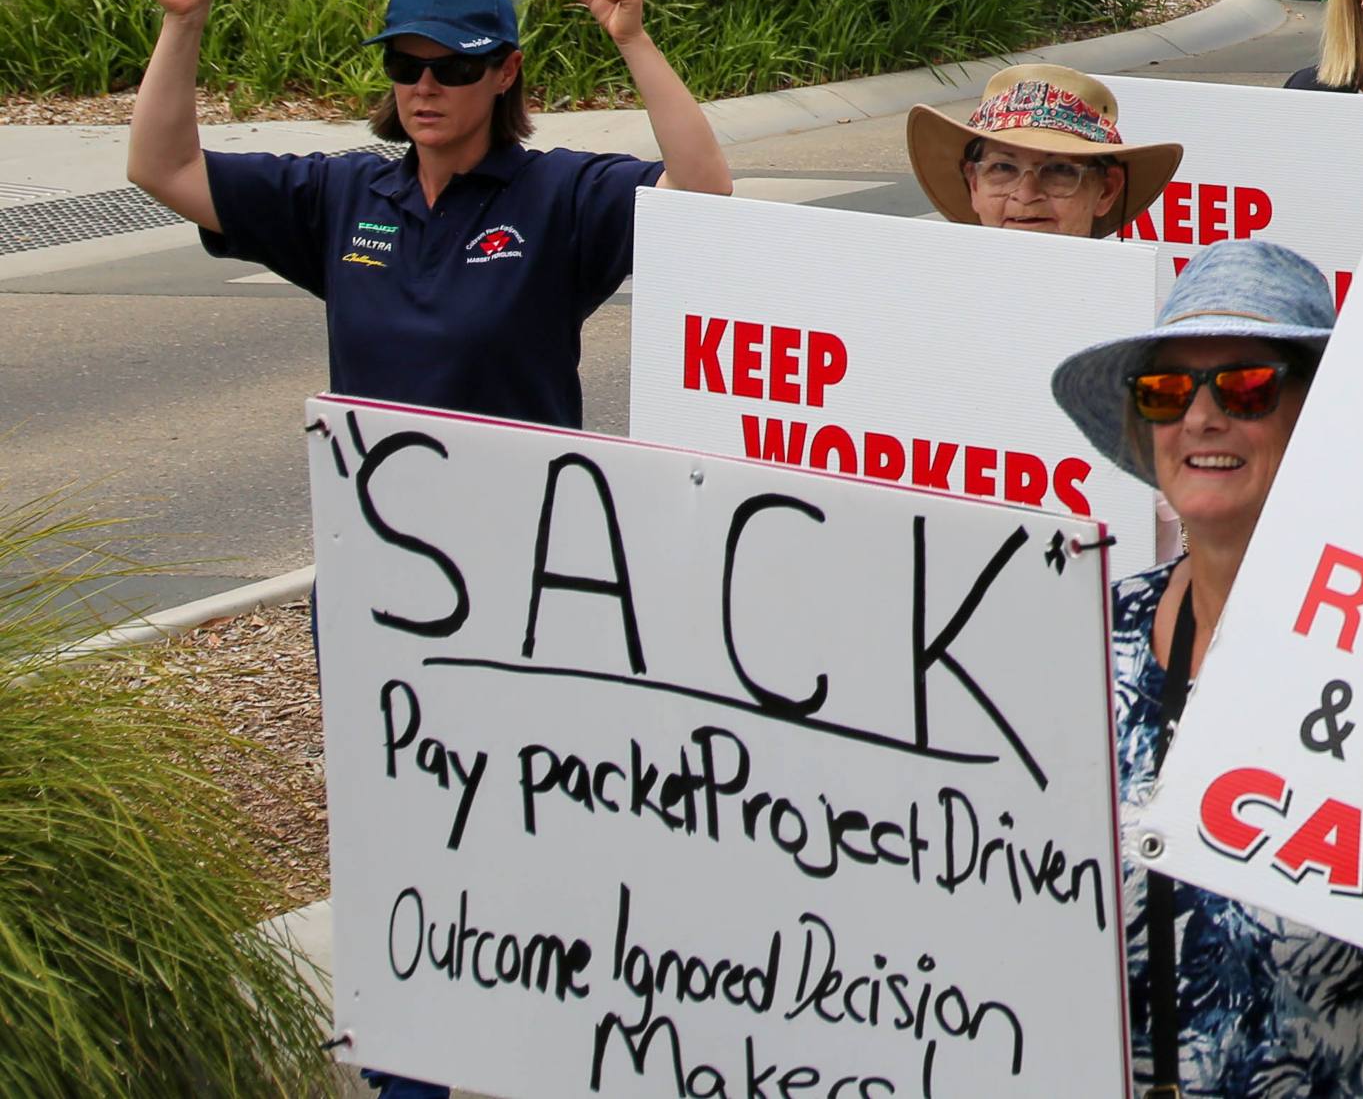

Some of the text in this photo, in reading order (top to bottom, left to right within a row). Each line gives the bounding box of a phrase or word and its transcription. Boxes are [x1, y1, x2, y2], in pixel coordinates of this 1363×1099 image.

[353, 236, 392, 252] VALTRA
[682, 314, 848, 408] KEEP
[741, 413, 1092, 517] WORKERS
[1299, 678, 1357, 761] &
[380, 679, 487, 850] Pay
[692, 725, 929, 878] Project
[936, 786, 1107, 931] Driven
[388, 882, 1024, 1076] Outcome Ignored Decision
